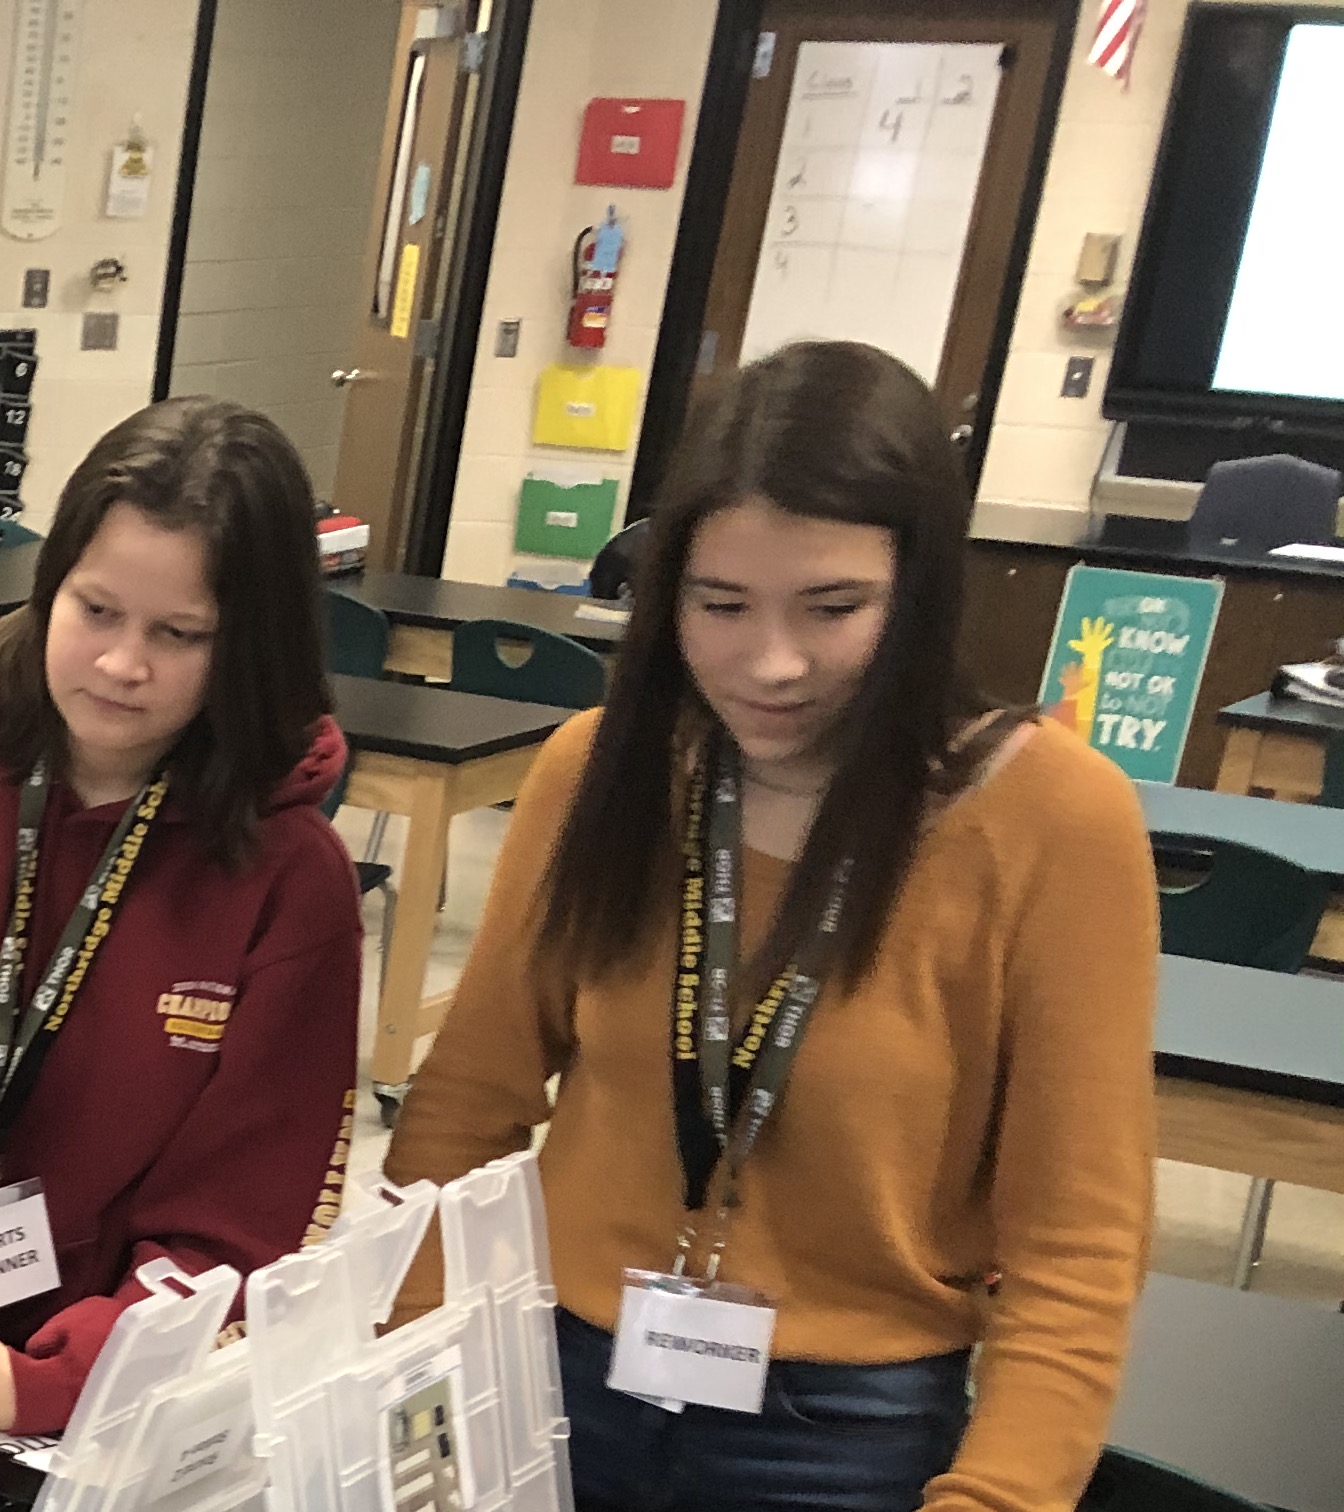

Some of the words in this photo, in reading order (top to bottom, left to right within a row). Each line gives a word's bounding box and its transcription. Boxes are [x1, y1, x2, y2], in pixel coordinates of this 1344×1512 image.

[878, 108, 904, 144] 4
[781, 204, 800, 237] 3
[15, 362, 29, 378] 6
[6, 408, 27, 426] 12
[1118, 626, 1191, 656] KNOW
[1105, 671, 1145, 691] NOT
[1147, 675, 1177, 695] OK
[43, 906, 113, 1033] Northridge
[100, 822, 150, 905] Middle
[137, 778, 169, 821] Sch
[681, 876, 705, 969] Middle
[676, 972, 701, 1061] School
